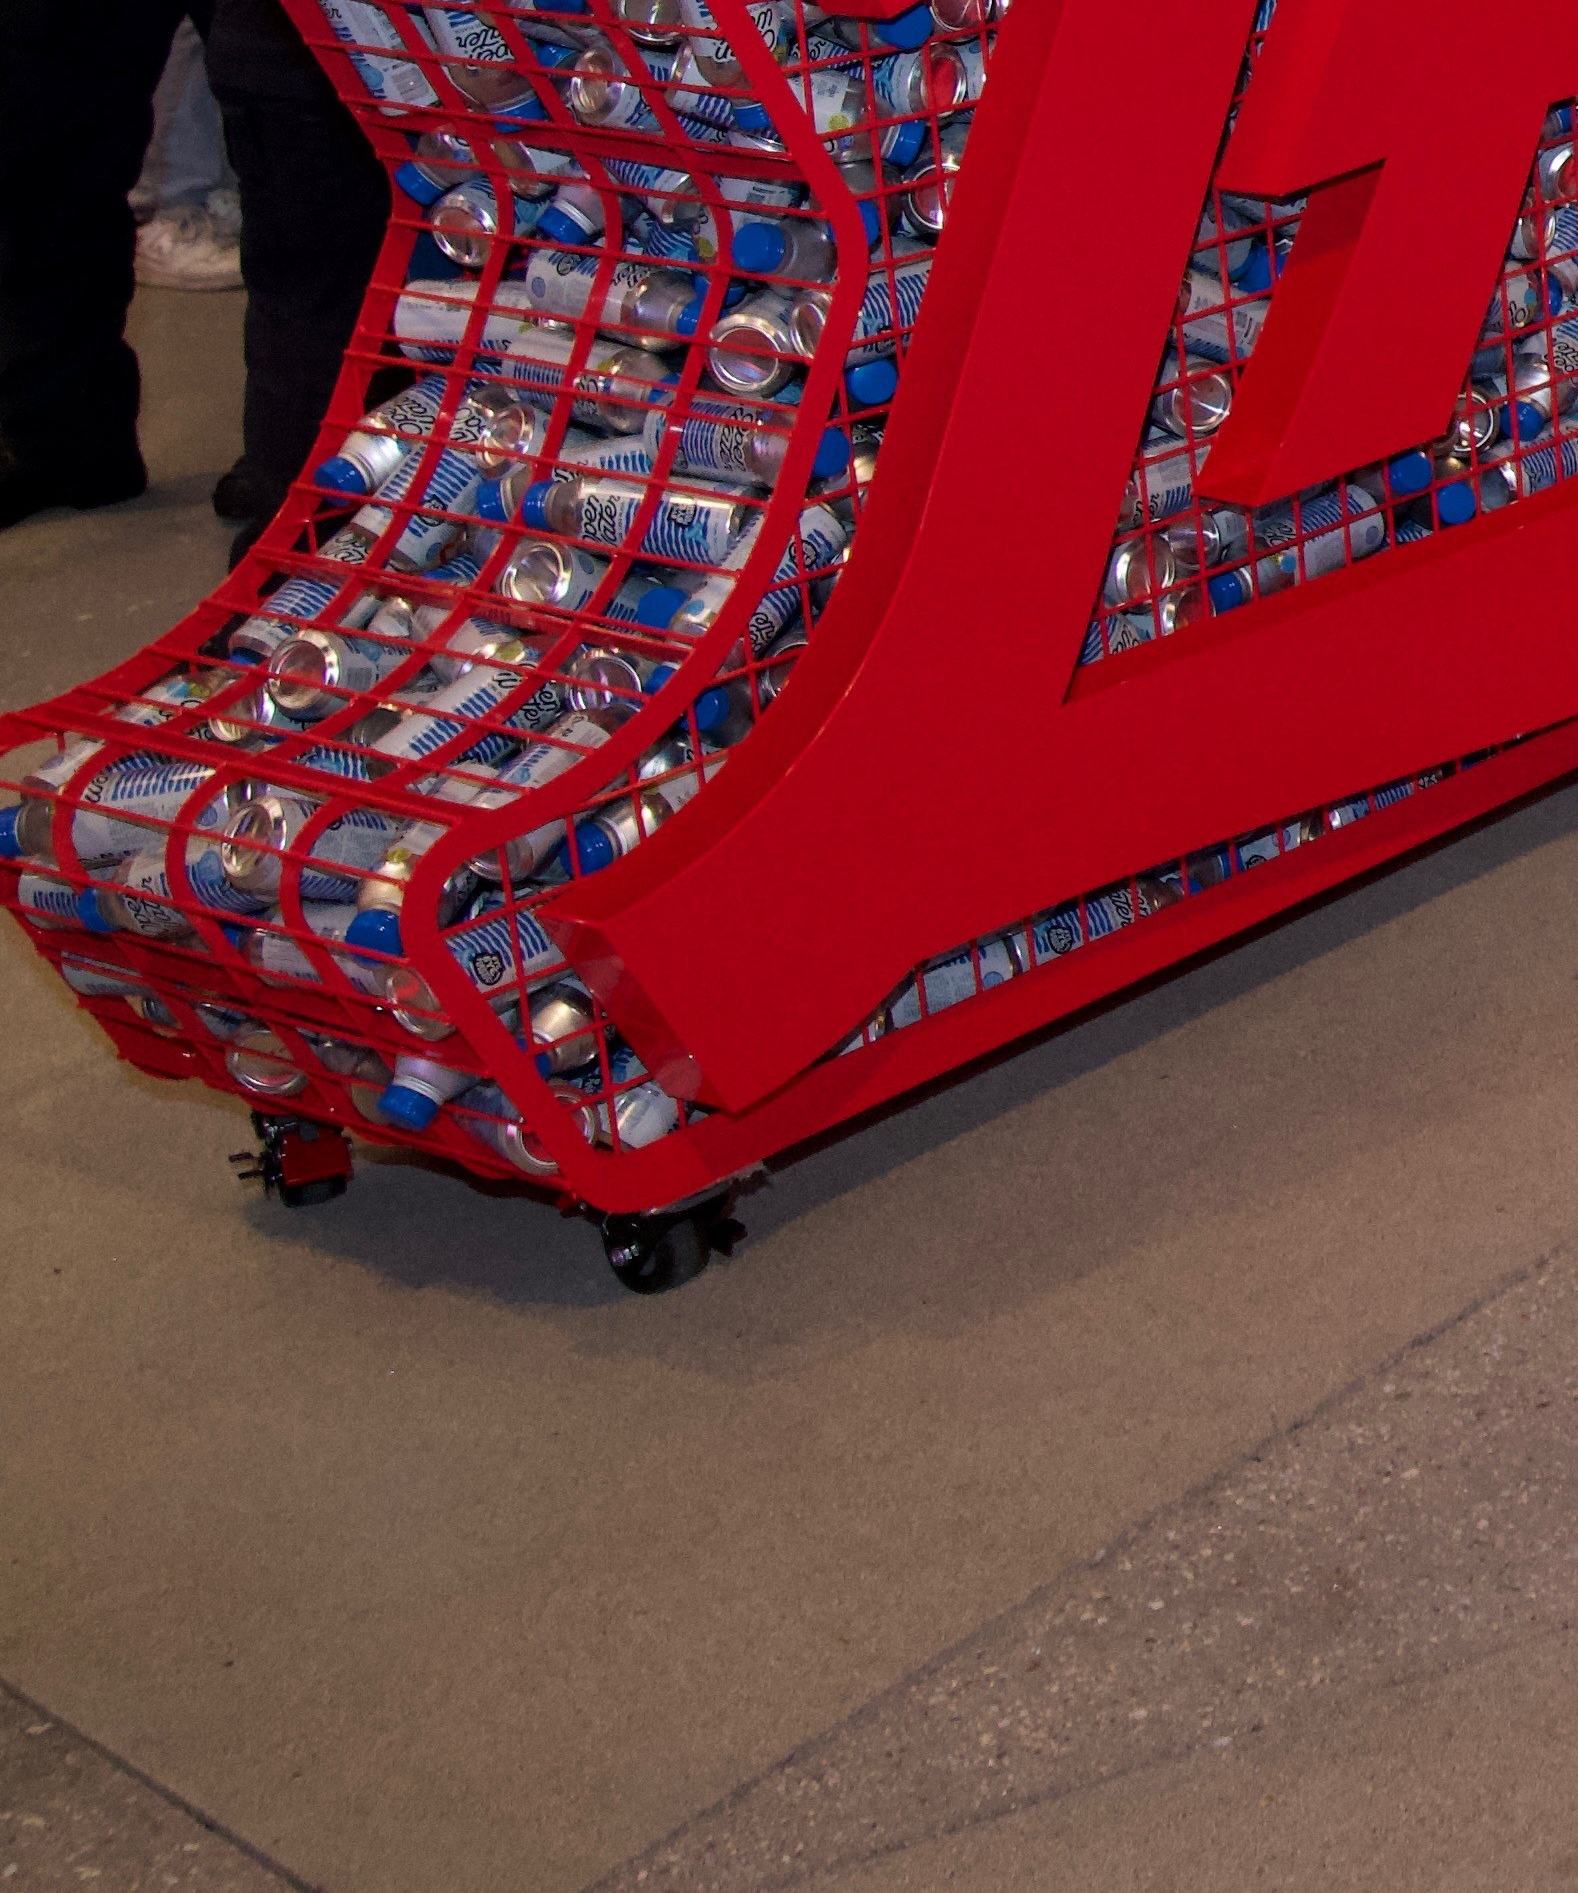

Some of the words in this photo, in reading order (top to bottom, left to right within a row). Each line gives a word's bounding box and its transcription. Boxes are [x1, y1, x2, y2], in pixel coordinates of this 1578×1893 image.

[455, 27, 502, 49] ater
[581, 495, 600, 541] pen
[596, 494, 621, 545] ater
